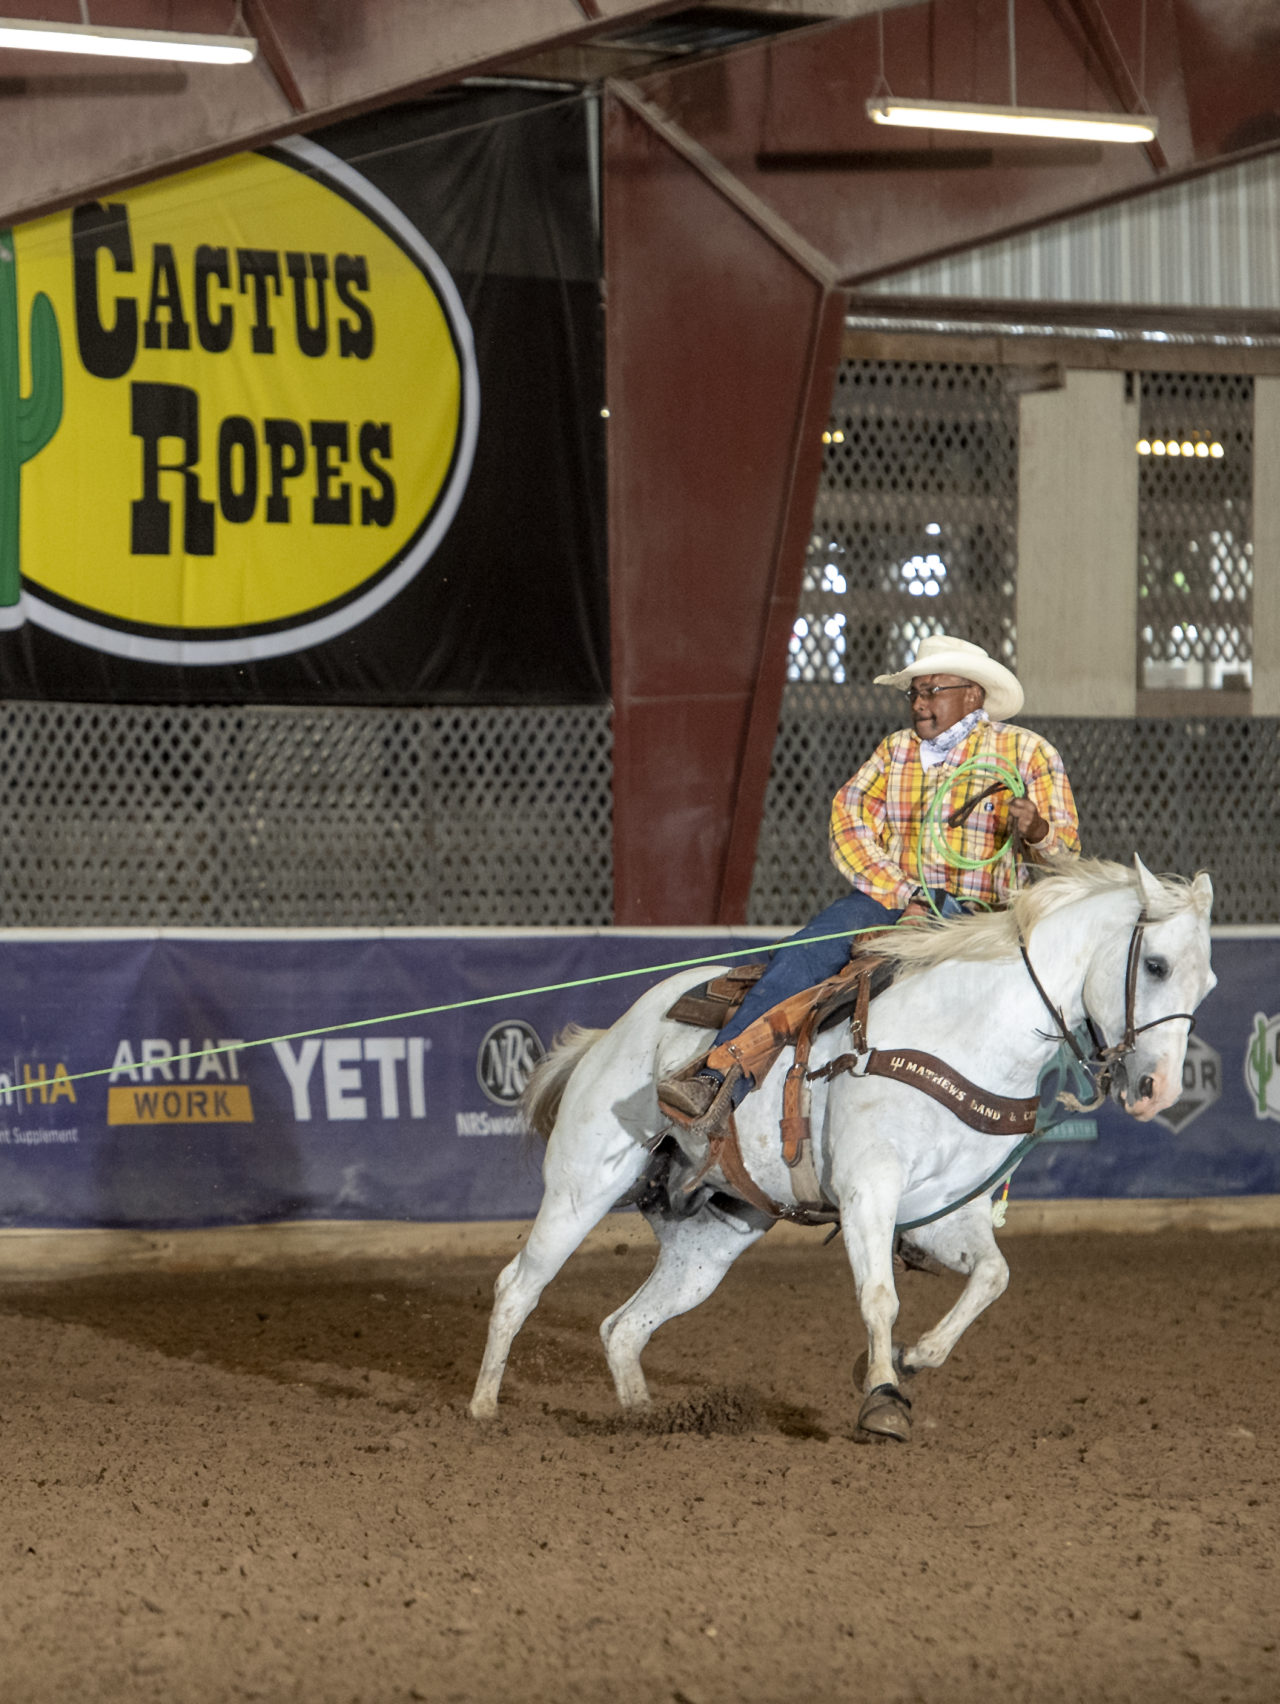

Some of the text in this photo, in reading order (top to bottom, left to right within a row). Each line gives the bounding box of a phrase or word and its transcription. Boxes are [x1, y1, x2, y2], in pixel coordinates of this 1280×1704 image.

[71, 200, 376, 379] CACTUS
[130, 381, 397, 556] ROPES
[109, 1038, 245, 1082] ARIAT
[271, 1037, 427, 1121] YETI
[24, 1063, 77, 1104] HA
[134, 1091, 231, 1119] WORK
[13, 1127, 78, 1145] Supplement
